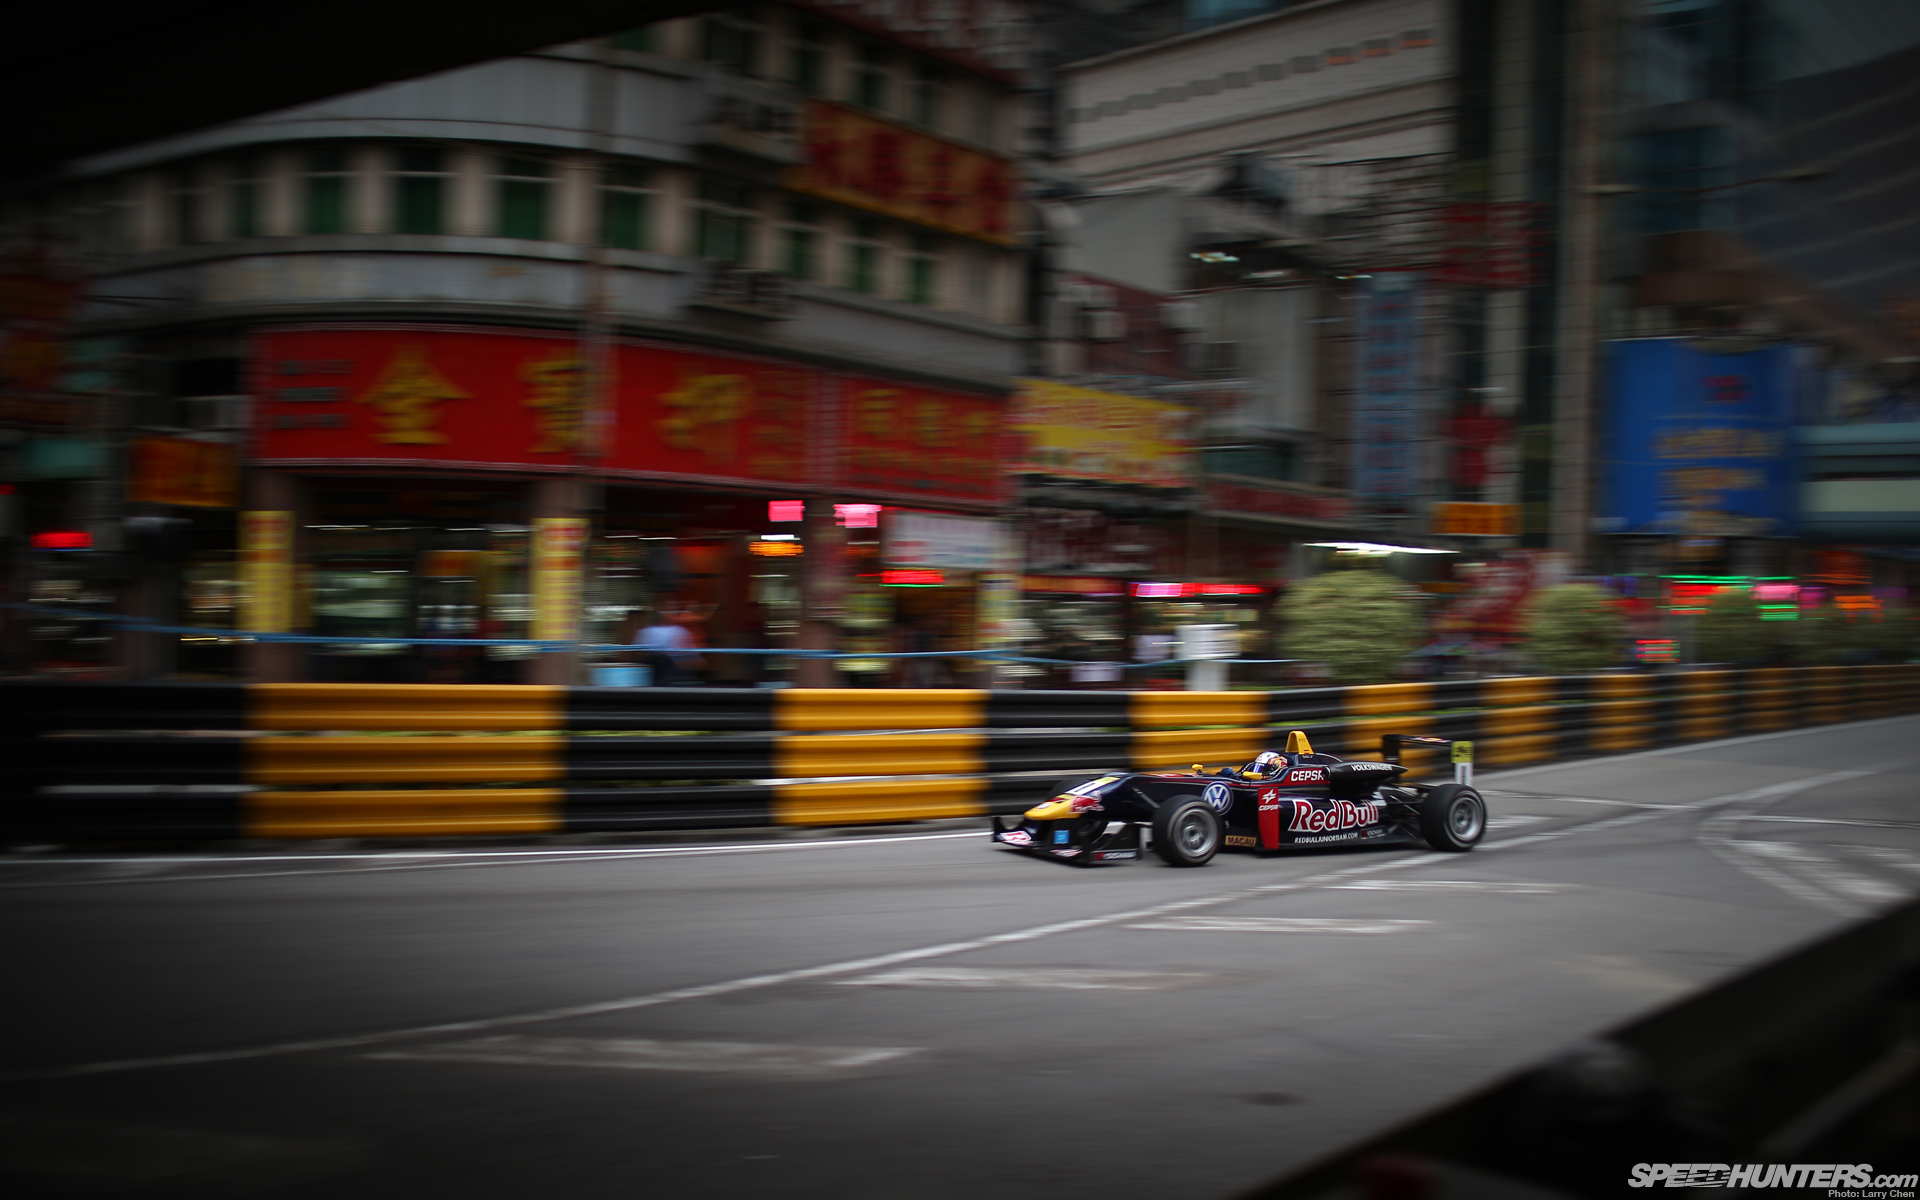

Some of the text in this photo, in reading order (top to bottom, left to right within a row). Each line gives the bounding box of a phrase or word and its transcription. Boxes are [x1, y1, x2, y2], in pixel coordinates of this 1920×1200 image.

[1350, 764, 1393, 772] VOLKSWAGEN
[1258, 804, 1279, 812] CEPSA
[1227, 836, 1255, 847] MACAU
[1294, 832, 1358, 844] REDBULLJUNIORTEAM.COM
